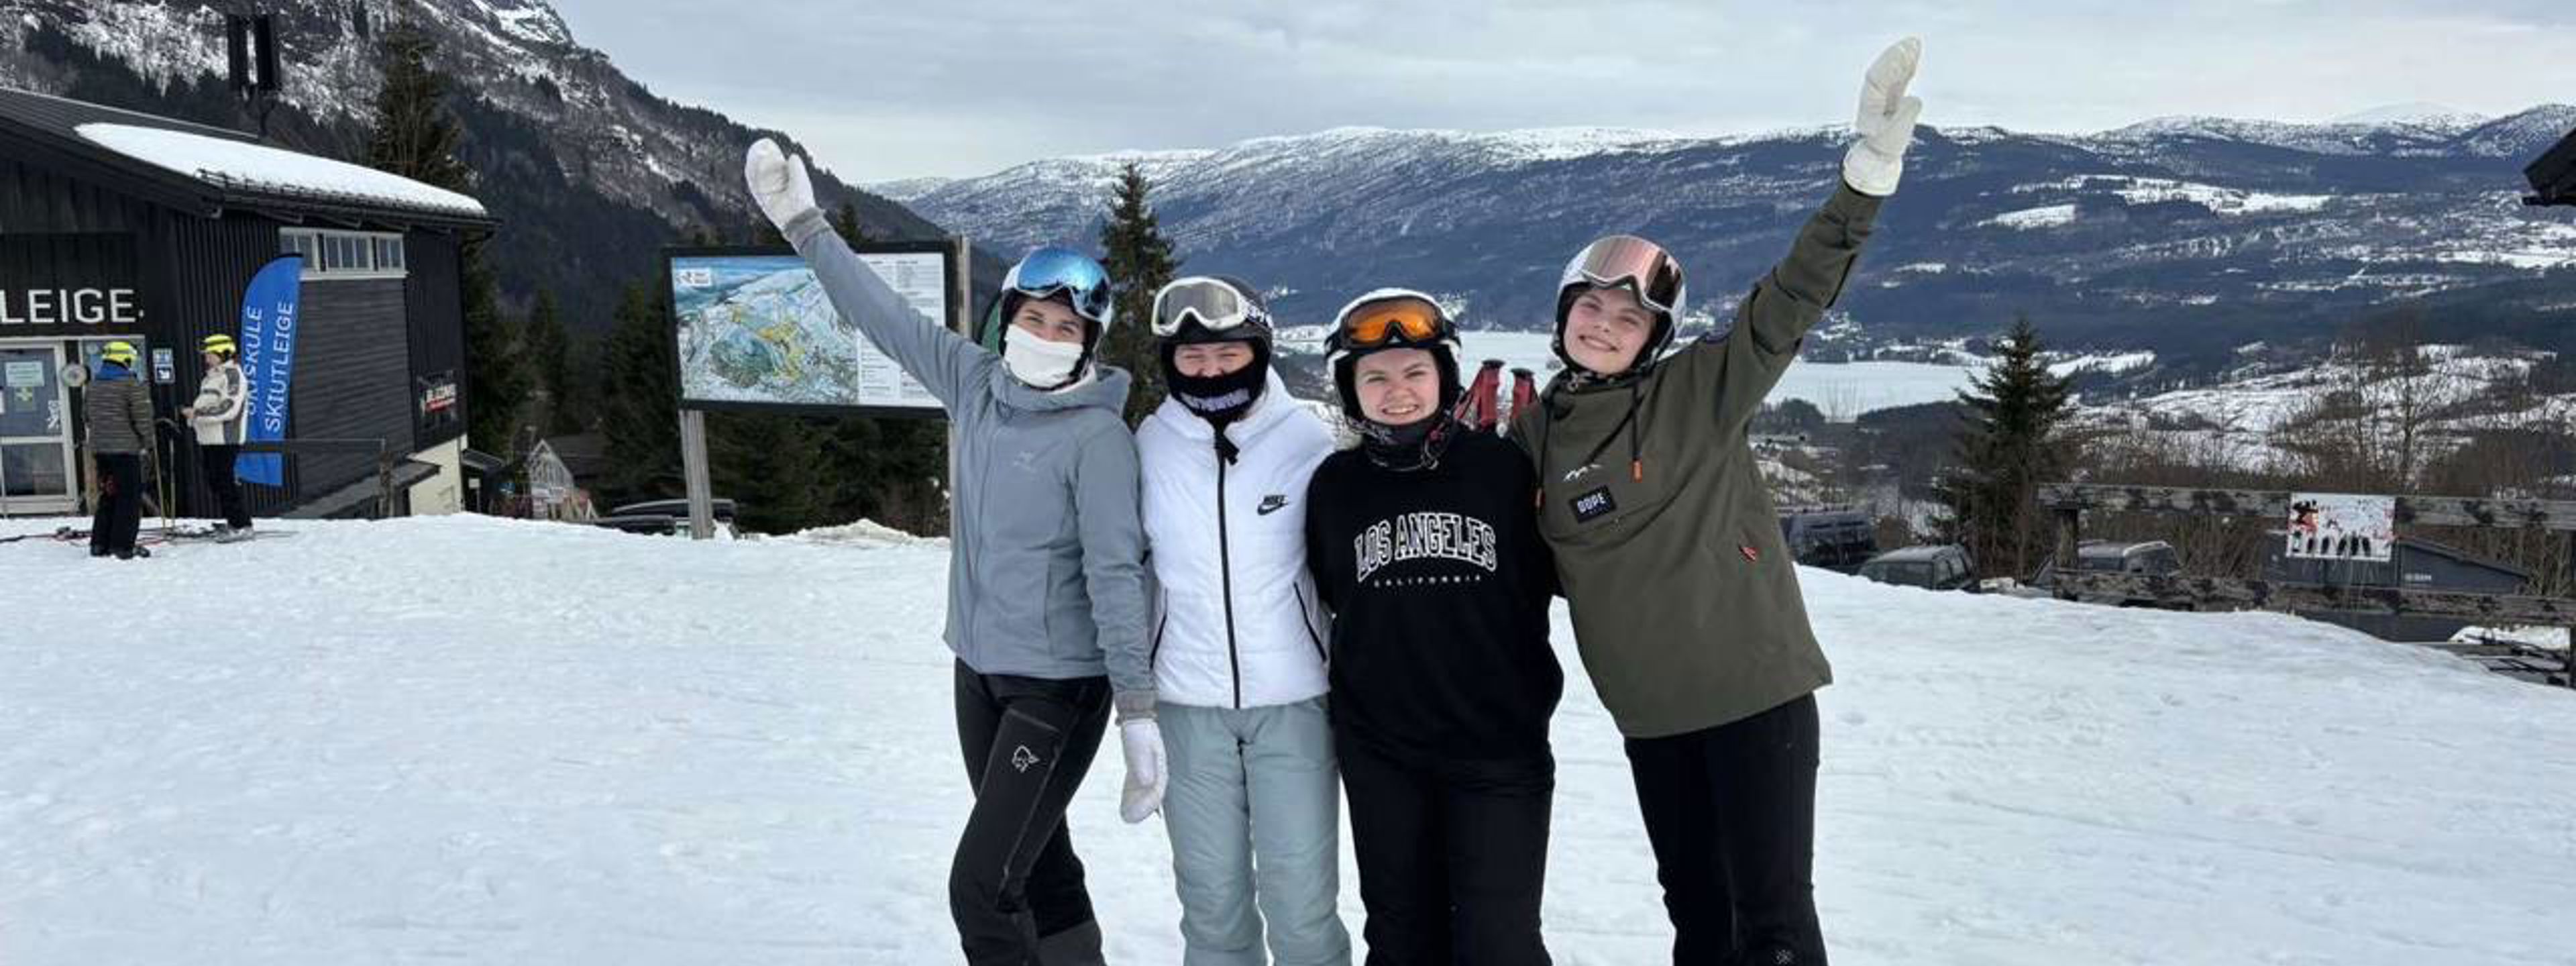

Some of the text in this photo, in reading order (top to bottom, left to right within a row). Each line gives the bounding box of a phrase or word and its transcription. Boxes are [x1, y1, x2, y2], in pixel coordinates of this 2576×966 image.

[266, 301, 292, 432] SKIUTLEIGE
[1354, 513, 1497, 583] LOS ANGELES
[1374, 575, 1481, 588] CALIFORNIA
